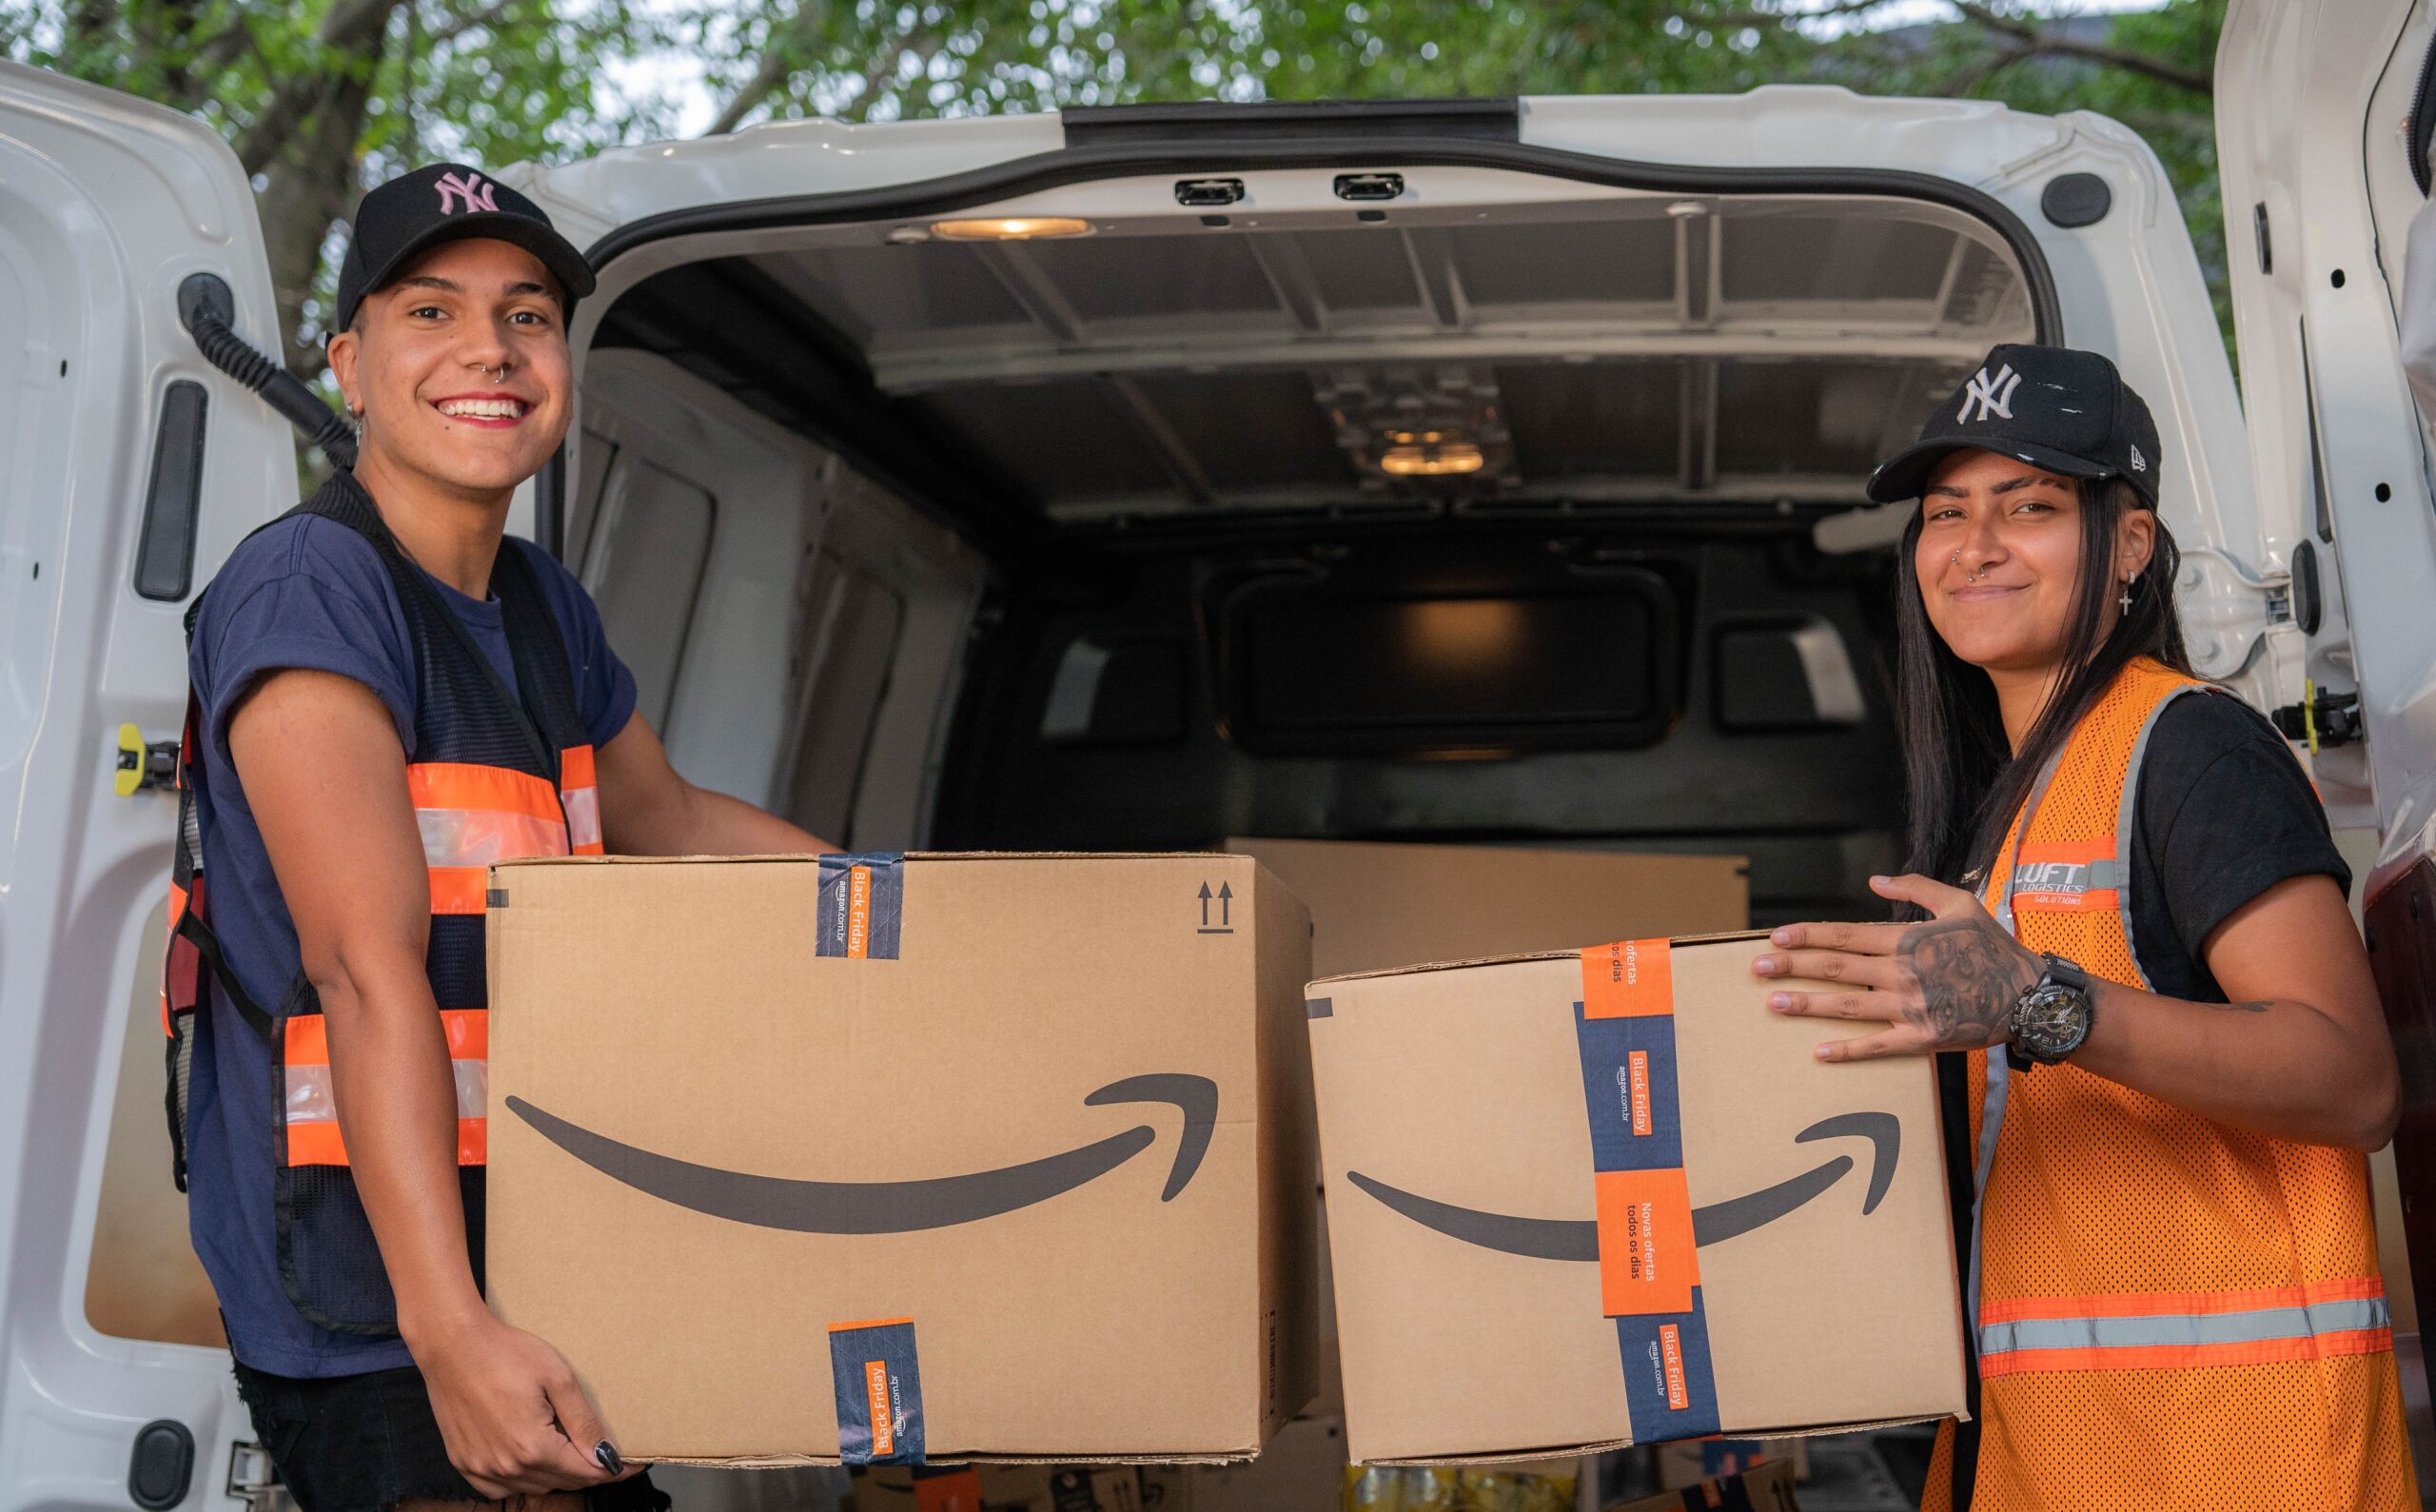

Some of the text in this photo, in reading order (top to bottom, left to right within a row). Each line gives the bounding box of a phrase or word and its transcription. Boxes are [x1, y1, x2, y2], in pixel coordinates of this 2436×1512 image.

[1955, 363, 2023, 425] NY
[836, 880, 846, 942] amazon.com.br
[848, 872, 866, 952] Black Friday
[2022, 883, 2084, 893] LOGISTICS
[2034, 895, 2082, 905] SOLUTIONS
[1612, 959, 1623, 982] dias
[1625, 945, 1637, 985] ofertas
[1619, 1066, 1630, 1122] amazon.com.br
[1633, 1057, 1647, 1131] Black Friday
[1627, 1205, 1641, 1279] todos os dias
[1641, 1203, 1655, 1282] Novas ofertas
[1651, 1340, 1666, 1397] amazon.com.br
[1664, 1331, 1683, 1405] Black Friday
[872, 1367, 889, 1449] Black Friday
[891, 1375, 903, 1438] amazon.com.br
